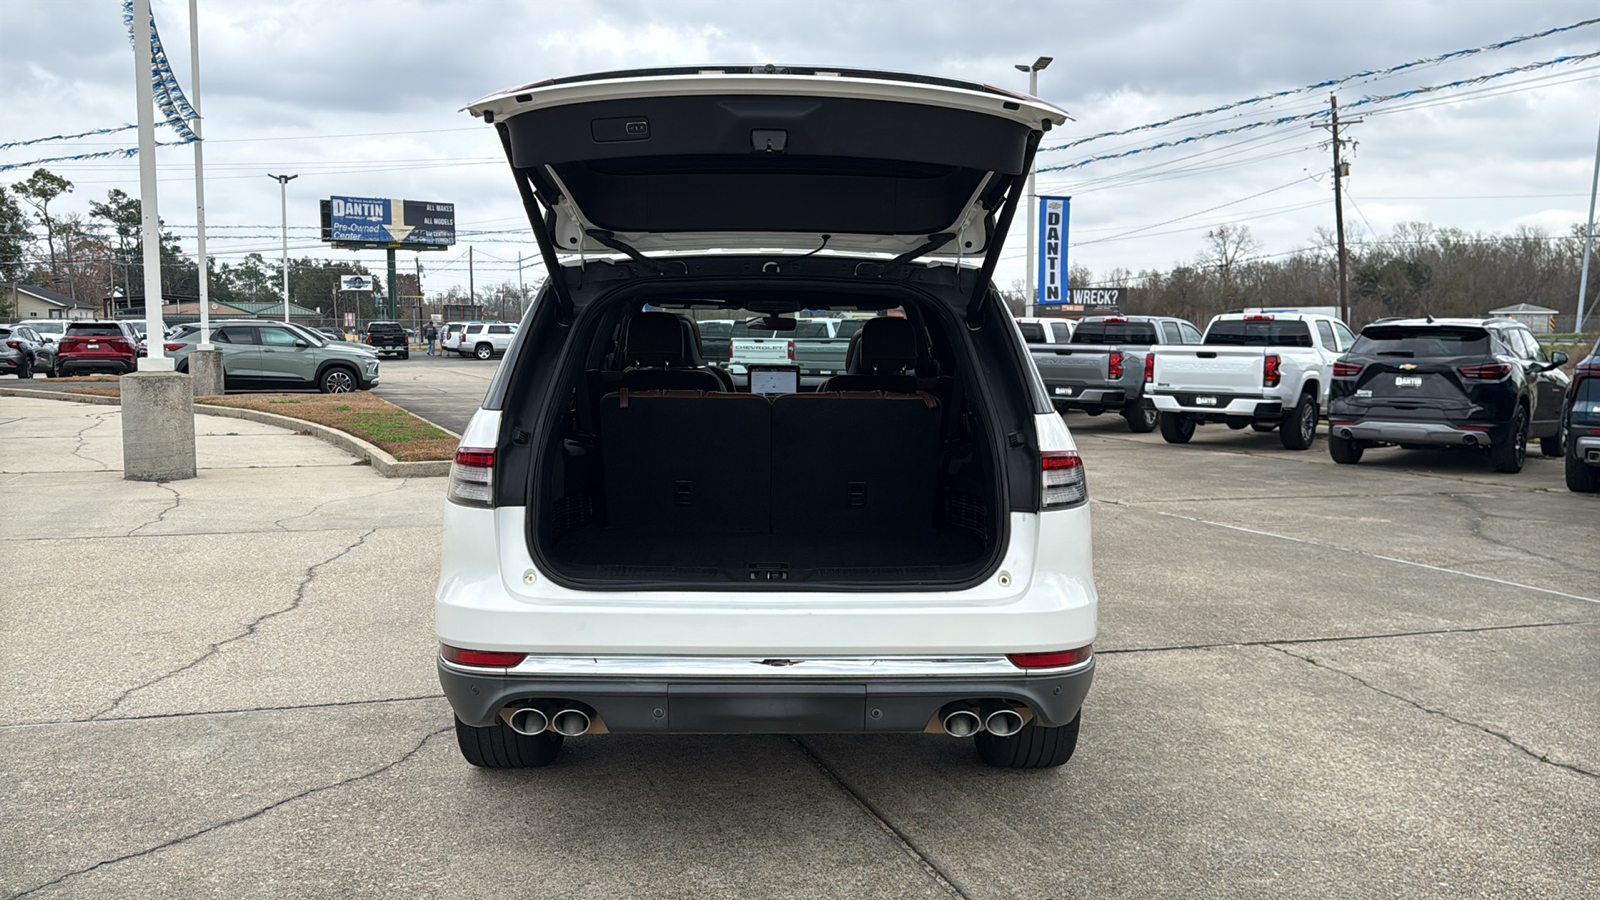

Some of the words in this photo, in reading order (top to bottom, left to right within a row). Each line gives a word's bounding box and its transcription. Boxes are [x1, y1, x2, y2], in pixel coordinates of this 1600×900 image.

[332, 198, 384, 217] DANTIN
[333, 222, 380, 233] Pre-Owned
[333, 231, 362, 240] Center
[1047, 212, 1060, 299] DANTIN
[1073, 289, 1119, 305] WRECK?
[1395, 376, 1422, 386] DANTIN
